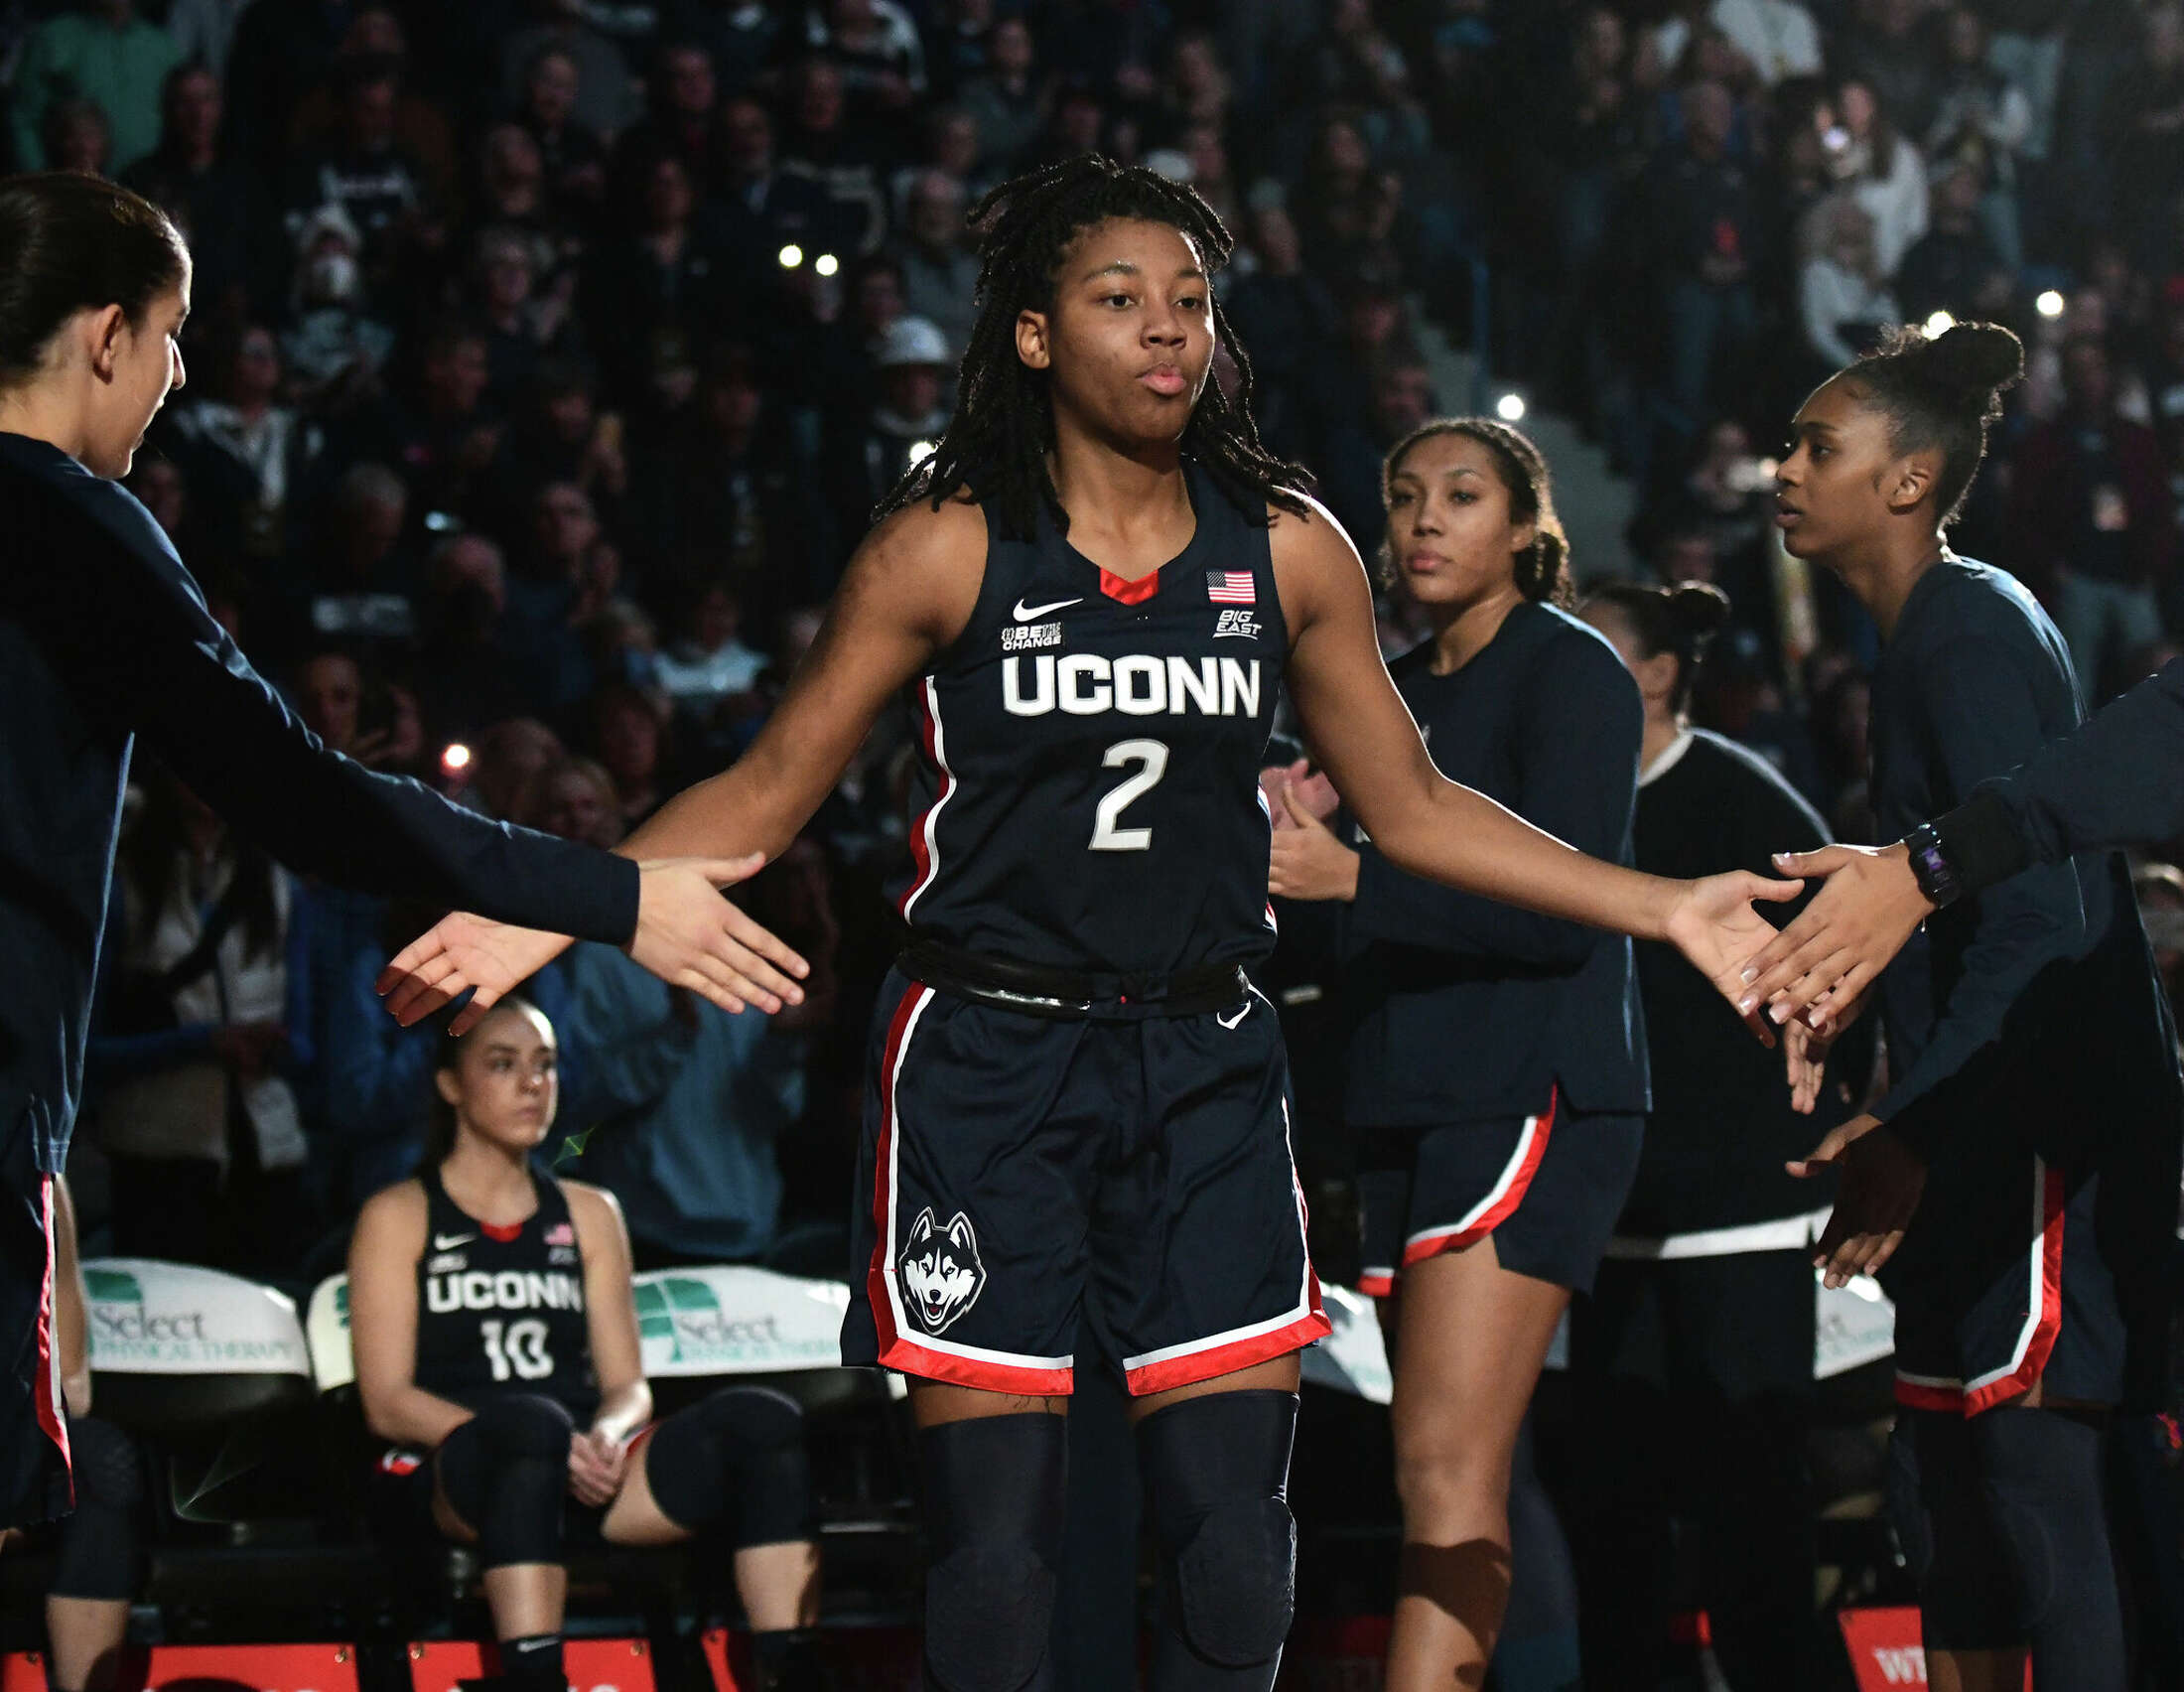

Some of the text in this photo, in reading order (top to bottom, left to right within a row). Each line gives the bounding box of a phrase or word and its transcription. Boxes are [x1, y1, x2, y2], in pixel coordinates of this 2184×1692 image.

[1216, 622, 1262, 634] EAST
[1219, 610, 1254, 623] BIG
[1003, 635, 1061, 651] CHANGE
[1002, 653, 1261, 718] UCONN
[1088, 738, 1169, 850] 2
[427, 1270, 583, 1314] UCONN
[479, 1317, 555, 1381] 10
